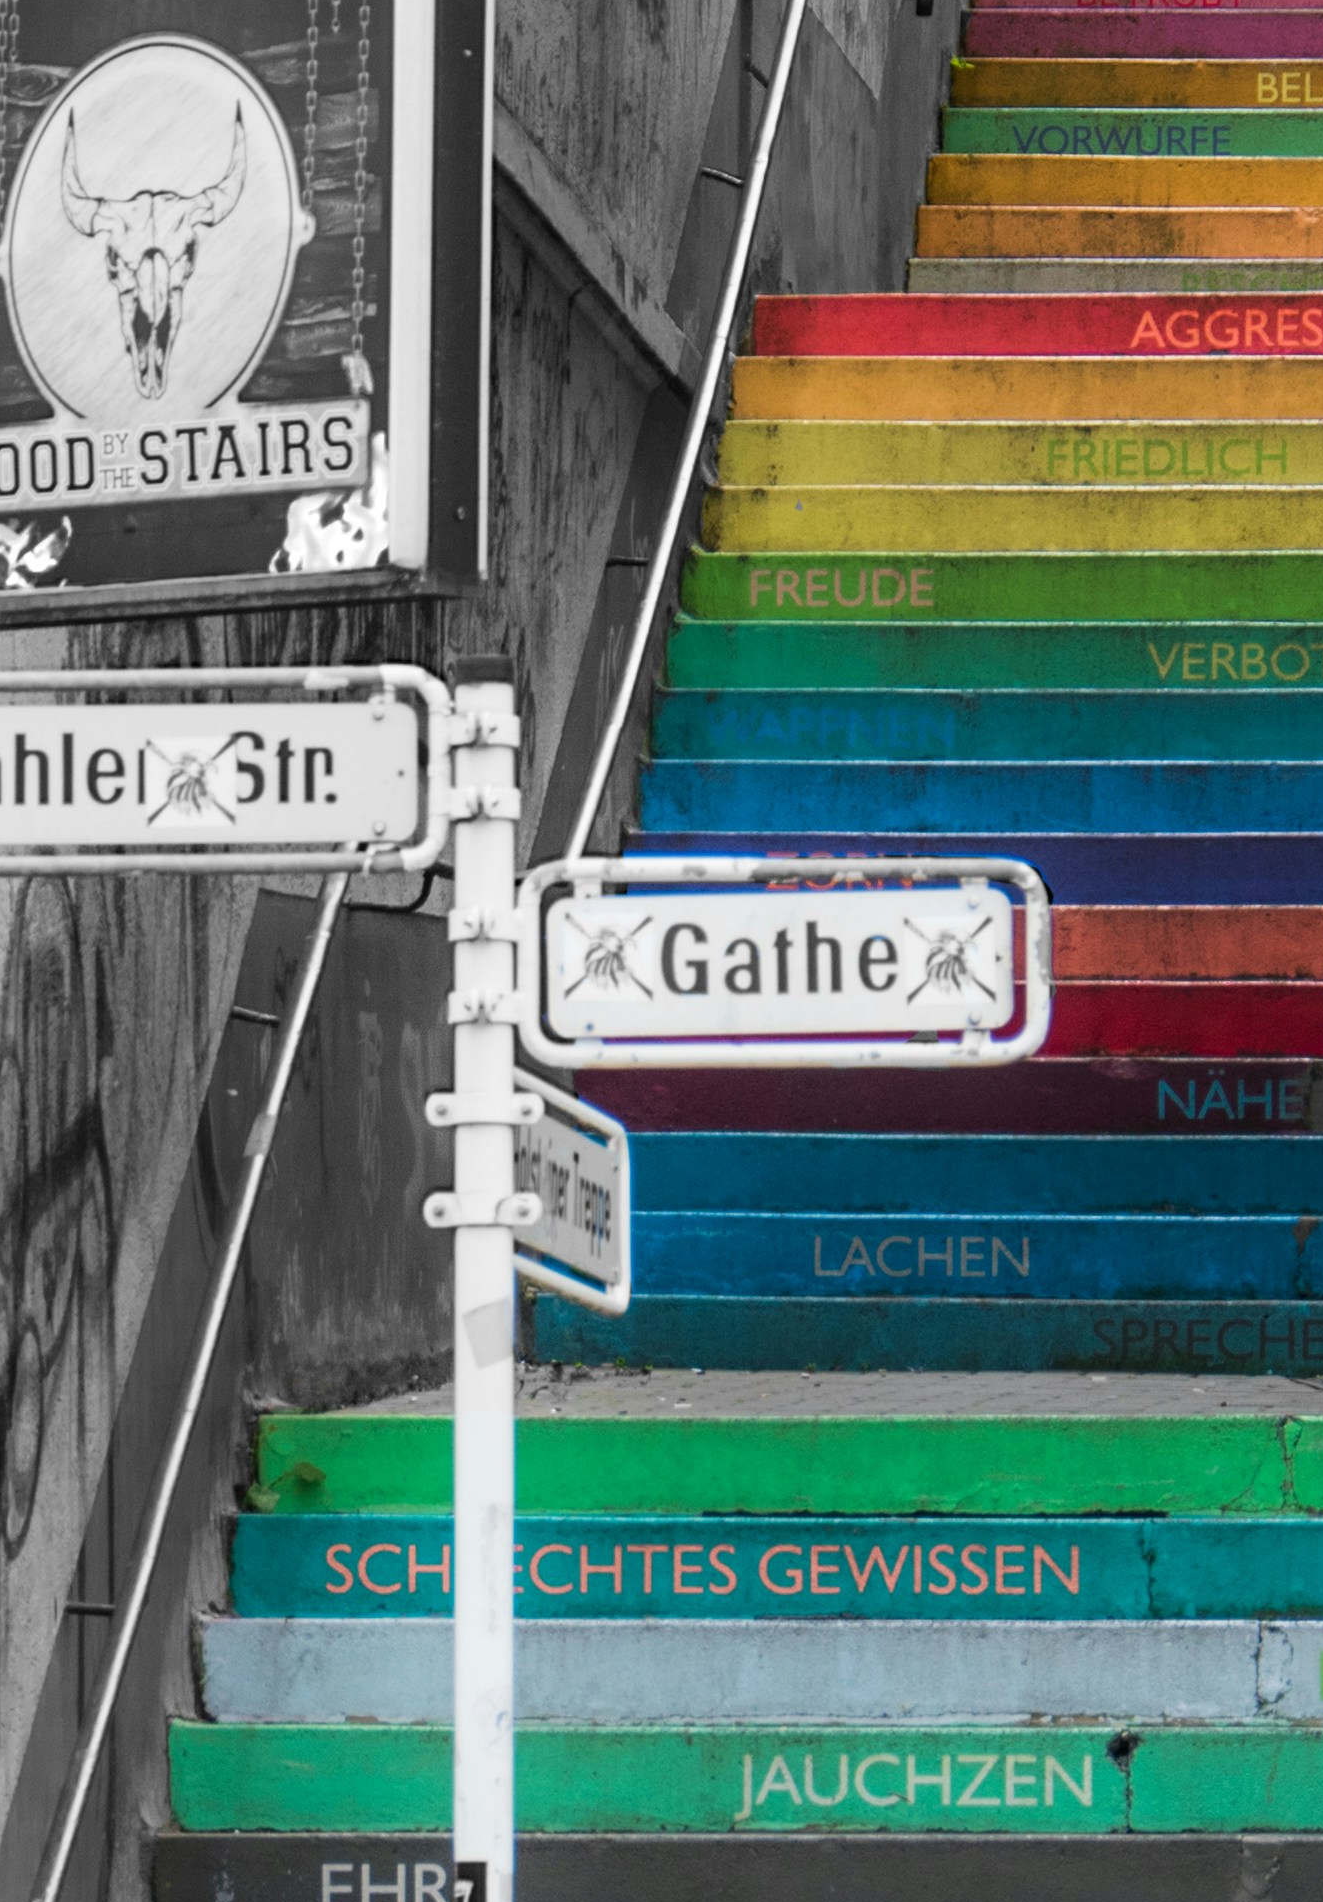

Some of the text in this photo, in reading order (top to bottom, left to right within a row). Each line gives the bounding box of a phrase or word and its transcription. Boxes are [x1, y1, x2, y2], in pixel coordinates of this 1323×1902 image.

[103, 433, 129, 454] BY
[138, 415, 354, 486] STAIRS
[1046, 439, 1288, 476] FRIEDLICH
[100, 466, 135, 489] THE
[749, 569, 933, 607] FREUDE
[234, 732, 338, 805] Str.
[660, 920, 899, 995] Gathe
[1157, 1069, 1307, 1121] NÄHE
[574, 1152, 611, 1259] Treppe
[814, 1237, 1029, 1278] LACHEN
[326, 1543, 1080, 1595] SCHECHTES GEWISSEN
[735, 1754, 1094, 1820] JAUCHZEN
